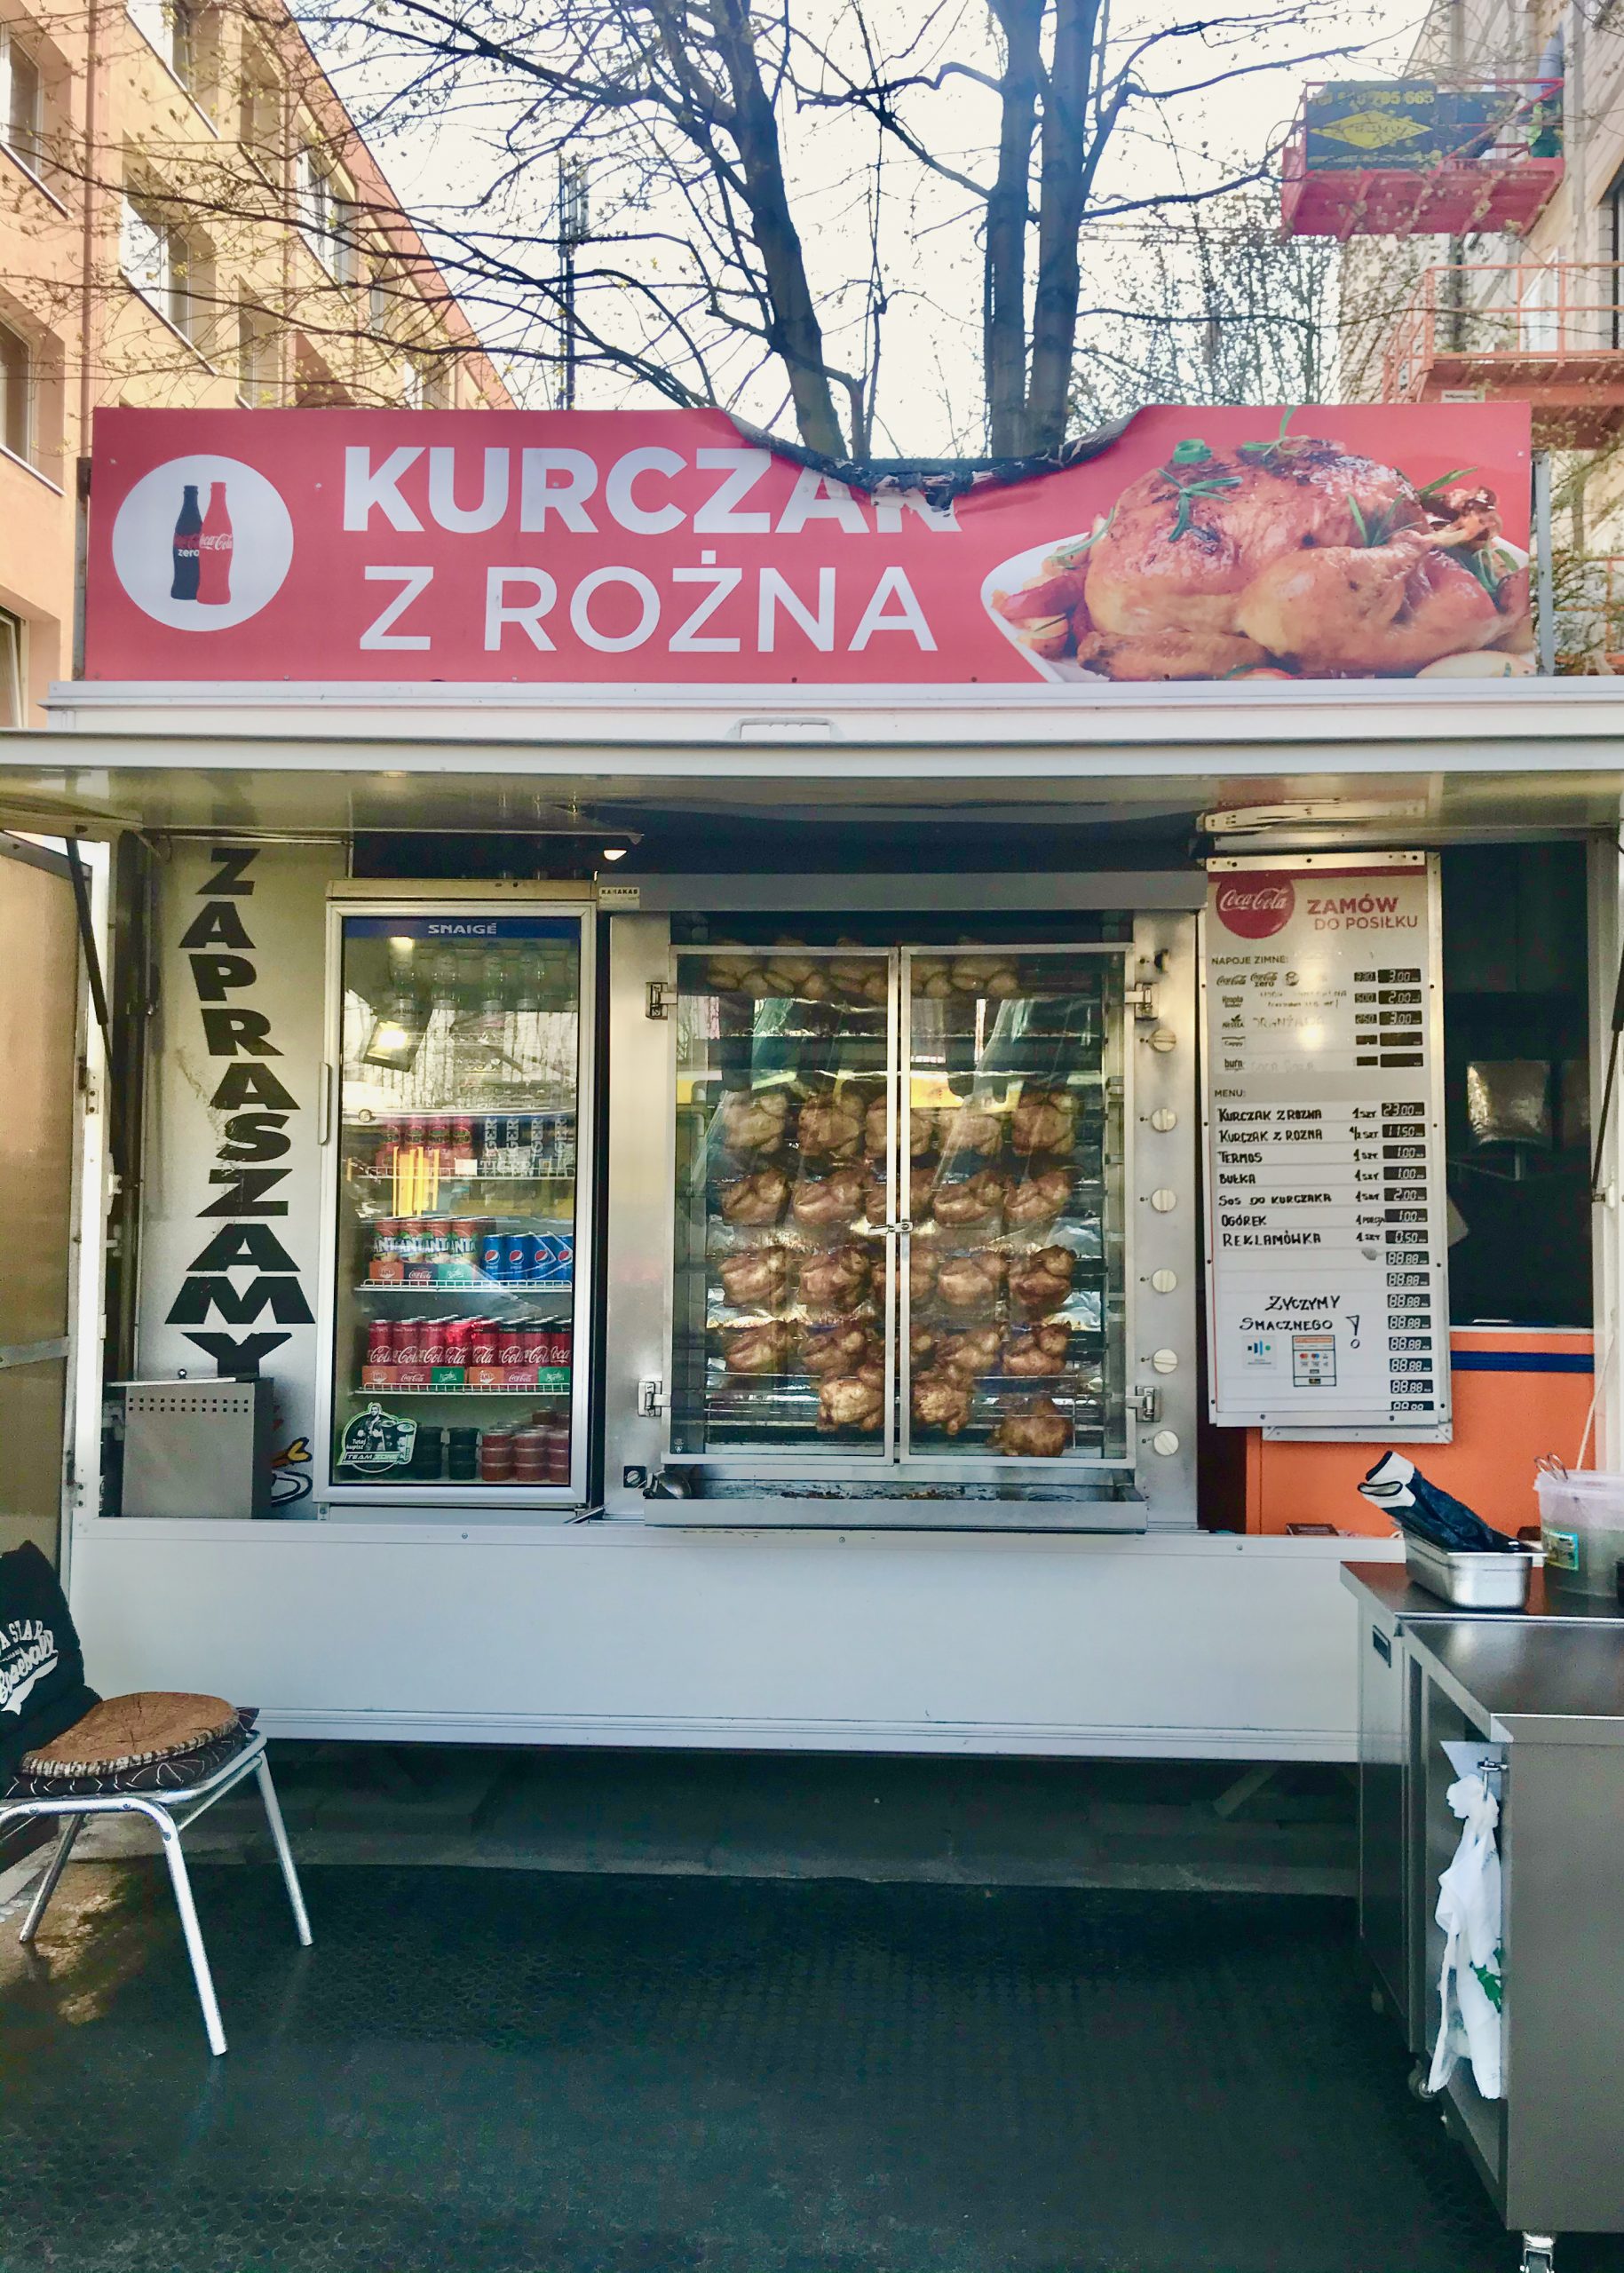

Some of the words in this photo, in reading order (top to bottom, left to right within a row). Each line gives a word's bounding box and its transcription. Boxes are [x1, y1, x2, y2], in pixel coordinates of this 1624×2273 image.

[178, 547, 200, 558] zero
[359, 565, 435, 652] Z
[484, 550, 938, 653] ROŻNA
[1306, 893, 1399, 915] ZAMÓW
[1314, 917, 1340, 931] DO
[1345, 915, 1418, 931] POSIŁKU
[1211, 956, 1251, 965] NAPOJE
[164, 848, 316, 1380] ZAPRASZAMY
[1217, 1108, 1271, 1122] KURCZAK
[1219, 1129, 1269, 1143] KURCZAK
[1217, 1151, 1263, 1163] TERMOS
[1221, 1215, 1266, 1227] OGÓREK
[1223, 1230, 1321, 1247] REKLAMÓWKA
[1239, 1317, 1334, 1331] SMACZNEGO
[8, 1620, 44, 1643] STAR
